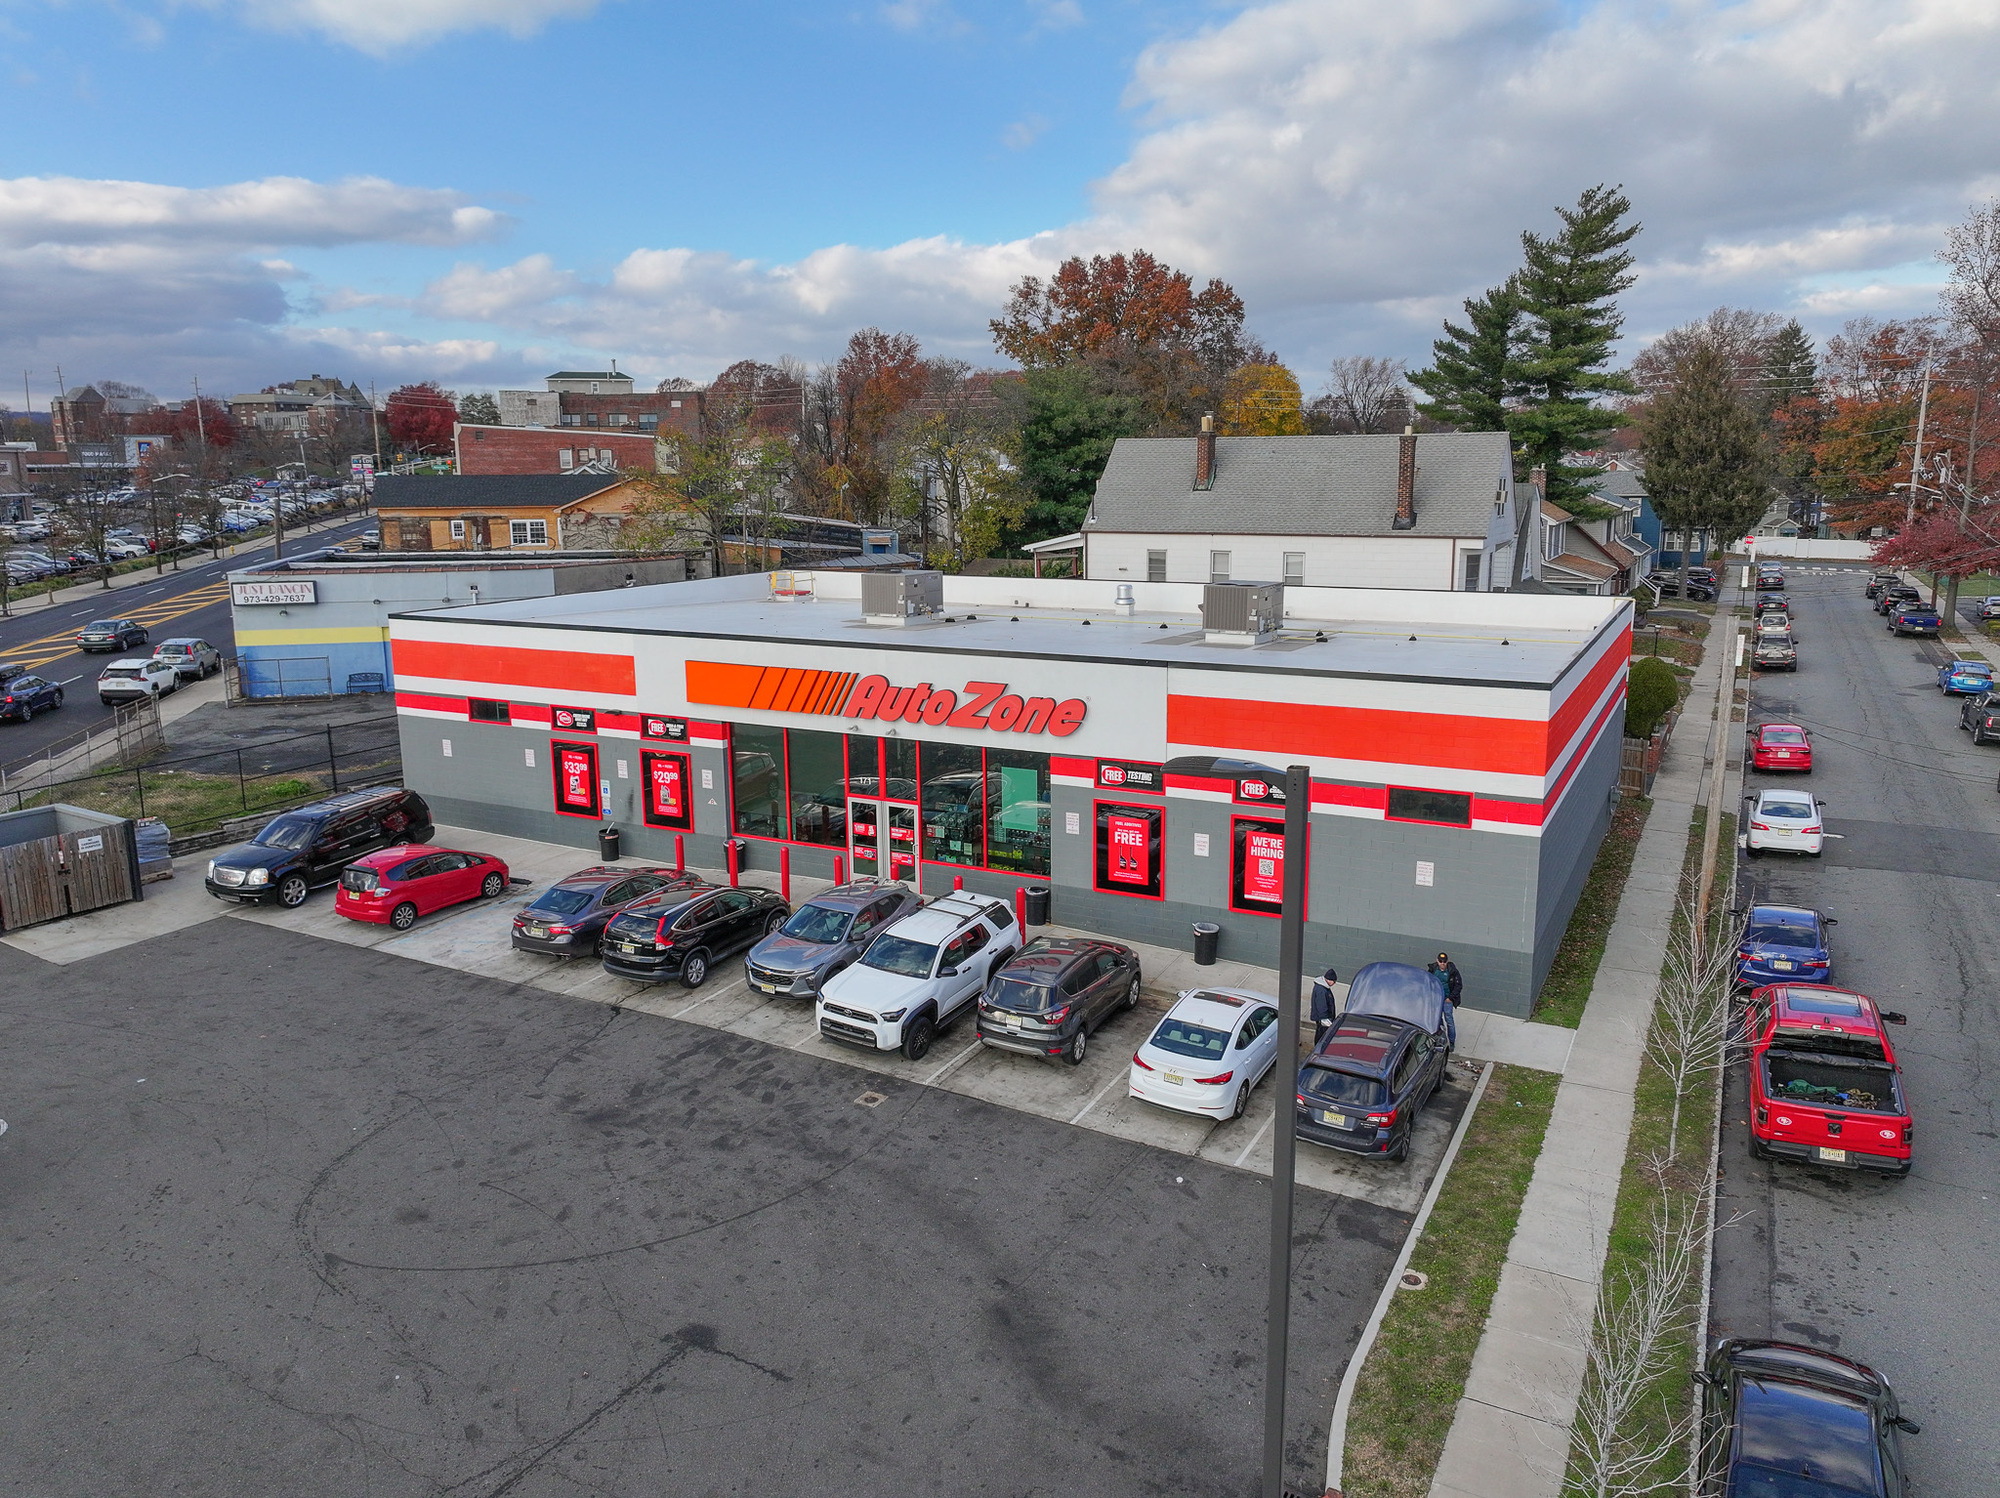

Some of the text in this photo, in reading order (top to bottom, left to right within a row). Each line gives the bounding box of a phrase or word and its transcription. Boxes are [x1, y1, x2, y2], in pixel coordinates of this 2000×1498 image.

[236, 584, 312, 595] JUST DANCIN
[243, 594, 306, 603] 973-429-7637
[843, 674, 1087, 737] AutoZone
[651, 722, 664, 733] FREE
[860, 777, 871, 785] 171
[1104, 770, 1153, 782] FREE TESTING
[1244, 782, 1264, 796] FREE
[1114, 831, 1143, 846] FREE
[1252, 835, 1283, 849] WE'RE
[1250, 846, 1284, 860] HIRING
